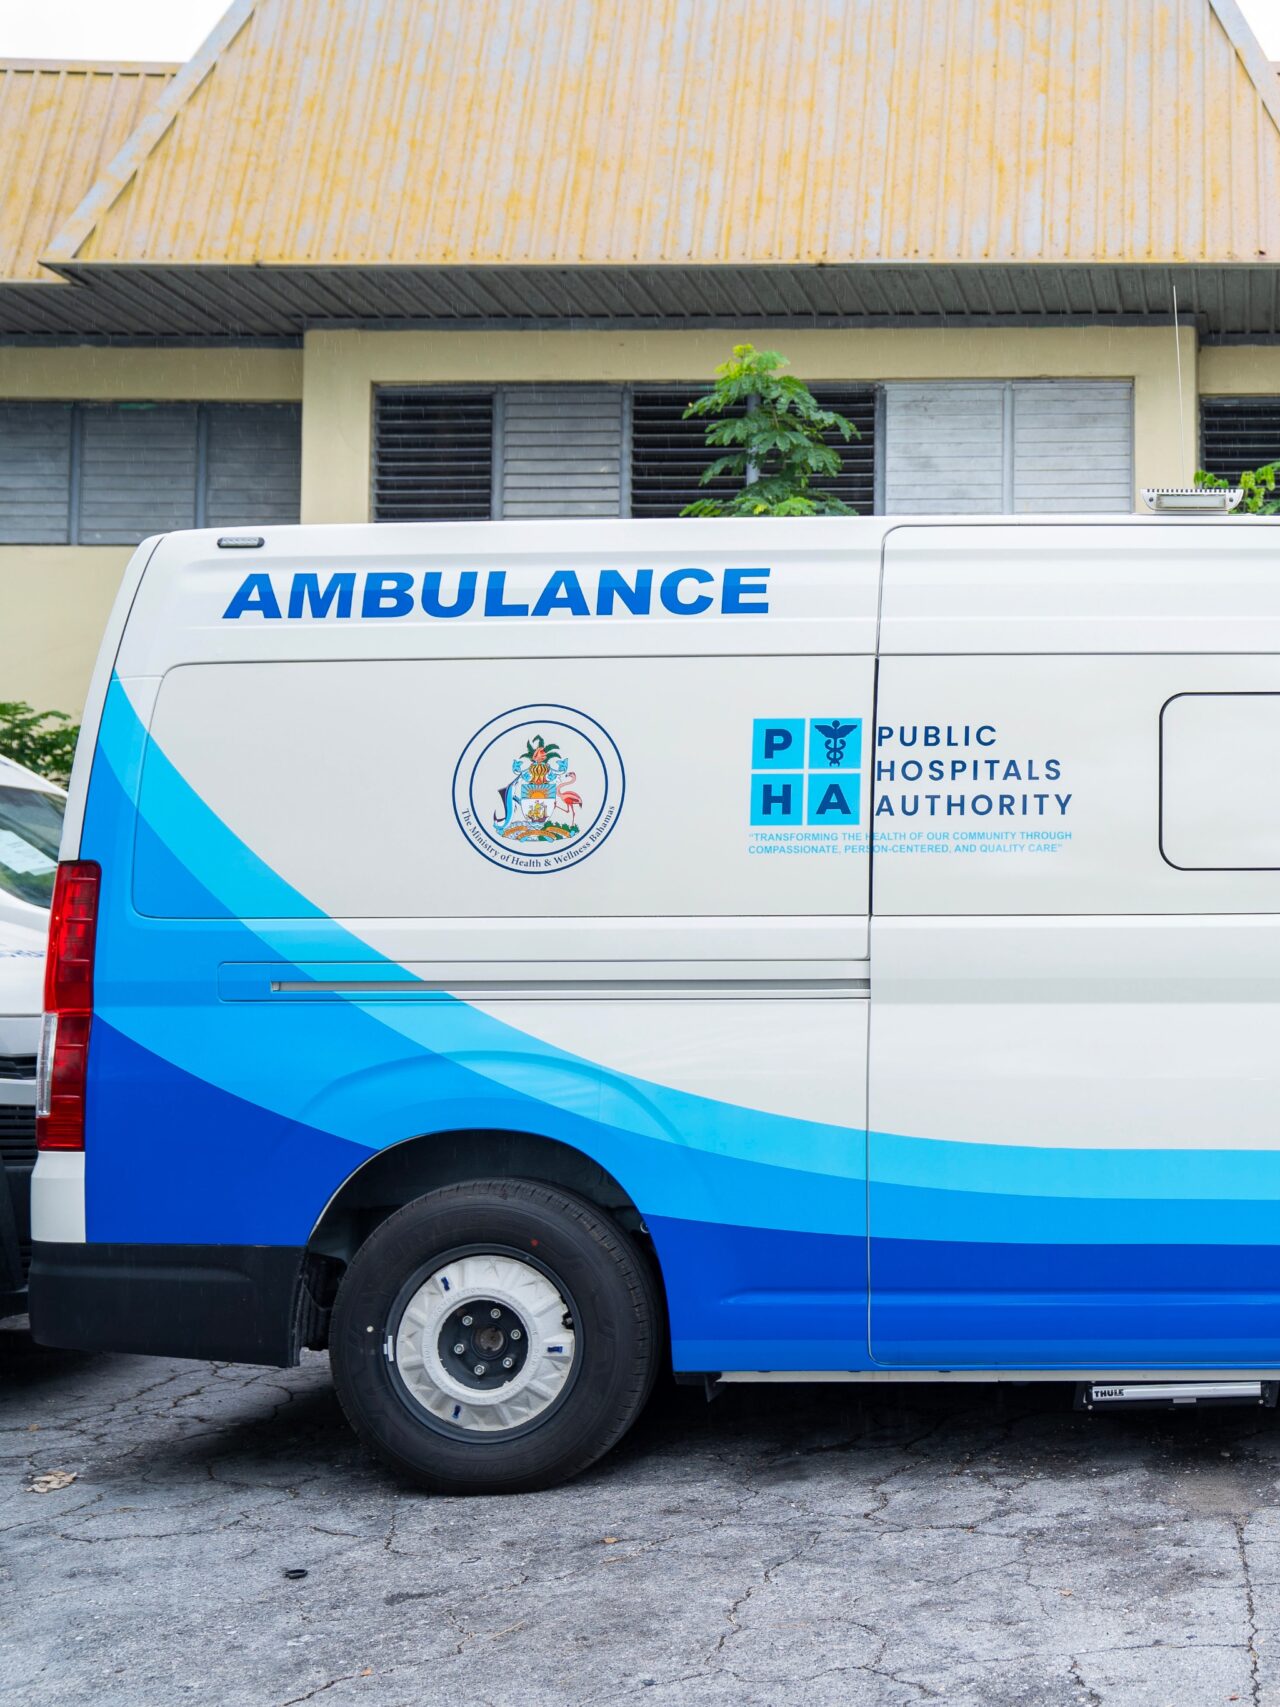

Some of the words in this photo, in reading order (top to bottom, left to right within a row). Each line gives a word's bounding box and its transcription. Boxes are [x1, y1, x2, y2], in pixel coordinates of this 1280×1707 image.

[222, 567, 771, 619] AMBULANCE
[764, 728, 793, 759] P
[877, 725, 997, 747] PUBLIC
[876, 759, 1062, 782] HOSPITALS
[762, 784, 792, 815] H
[815, 784, 852, 815] A
[874, 794, 1073, 817] AUTHORITY
[462, 808, 472, 827] The
[469, 826, 499, 858] Ministry
[500, 854, 512, 862] of
[511, 856, 541, 868] Health
[544, 859, 552, 867] &
[554, 842, 591, 865] Wellness
[589, 806, 615, 843] Bahamas
[842, 832, 865, 841] THE
[865, 832, 906, 841] HEALTH
[909, 832, 923, 841] OF
[927, 832, 949, 841] OUR
[953, 832, 1016, 841] COMMUNITY
[1020, 831, 1073, 840] THROUGH
[749, 845, 842, 855] COMPASSIONATE,
[954, 844, 977, 853] AND
[980, 844, 1025, 853] QUALITY
[1094, 1388, 1125, 1398] THULE
